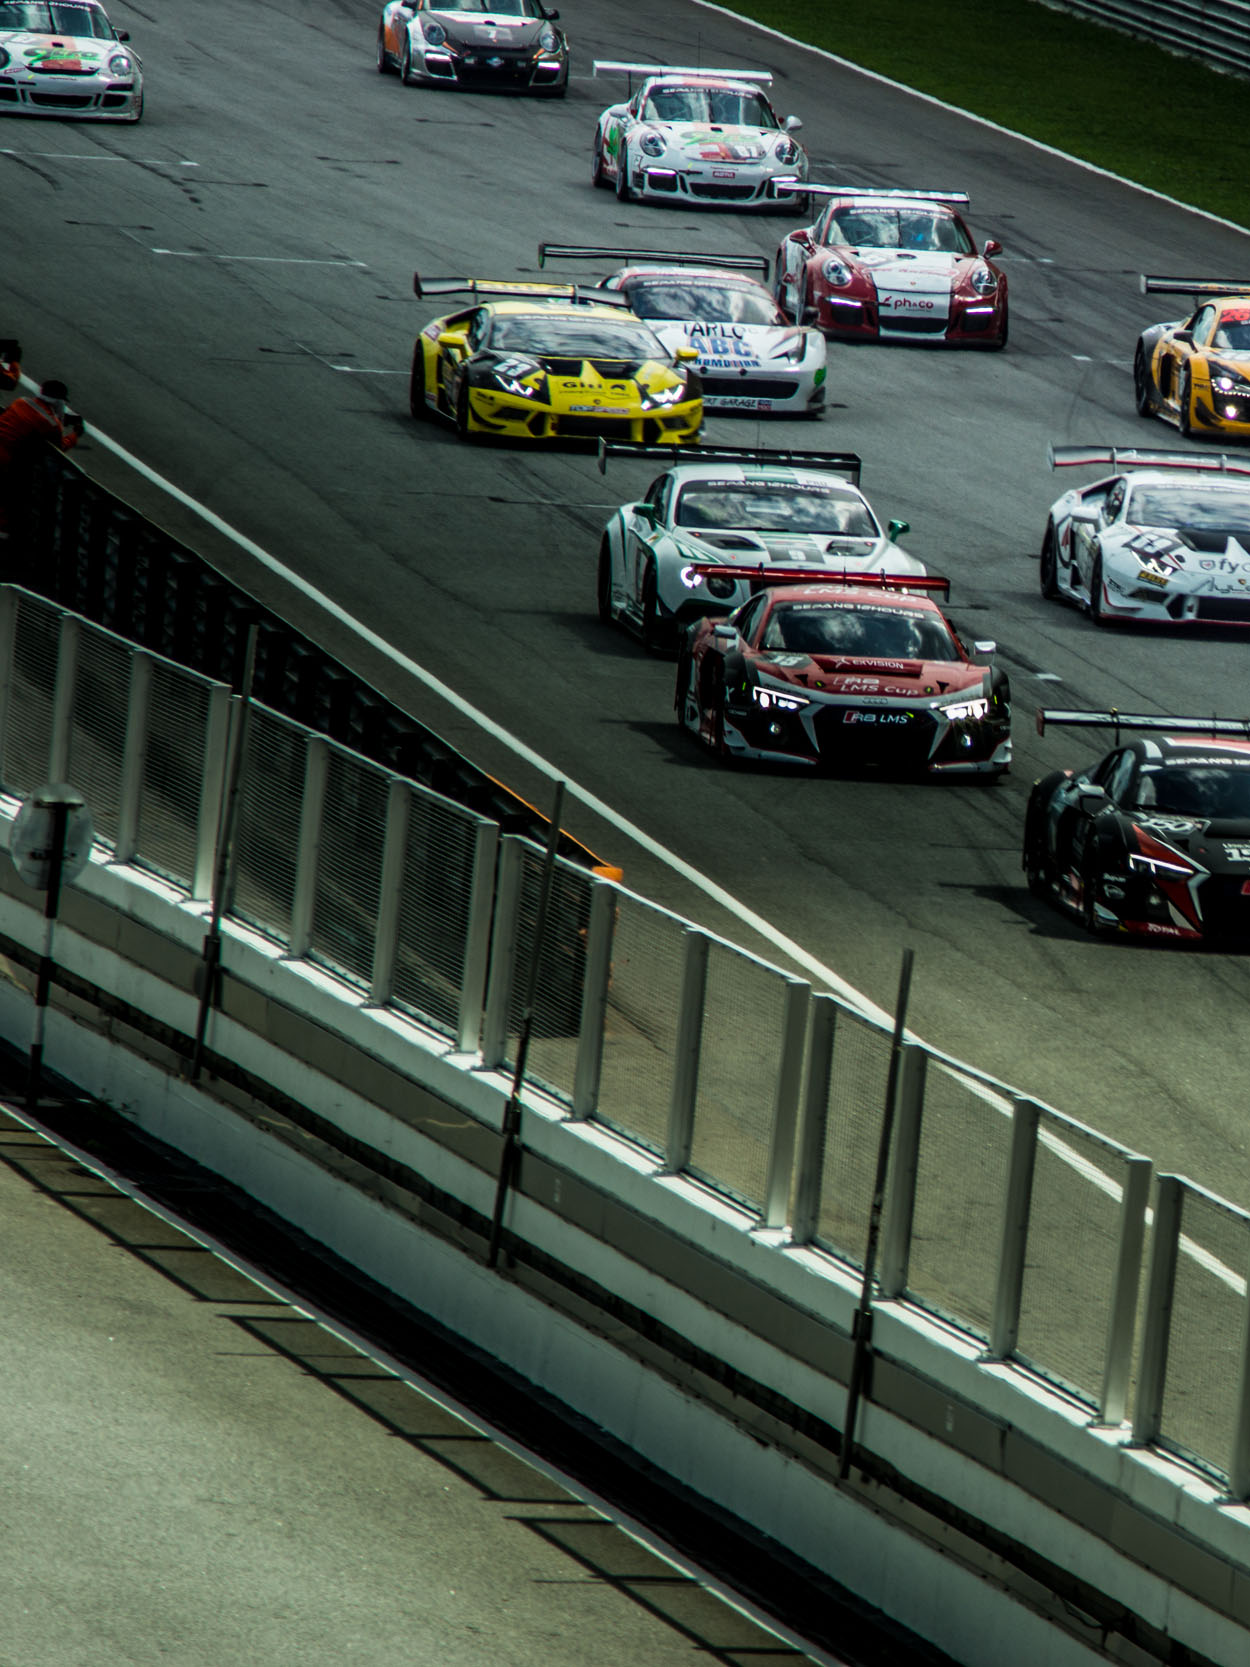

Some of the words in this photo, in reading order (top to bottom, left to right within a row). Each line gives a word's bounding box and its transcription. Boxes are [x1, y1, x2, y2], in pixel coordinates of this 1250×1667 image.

[792, 603, 855, 611] SEPANG
[857, 603, 926, 619] 12HOURS
[840, 684, 879, 693] LMS
[883, 685, 919, 697] Cup
[879, 713, 909, 724] LMS
